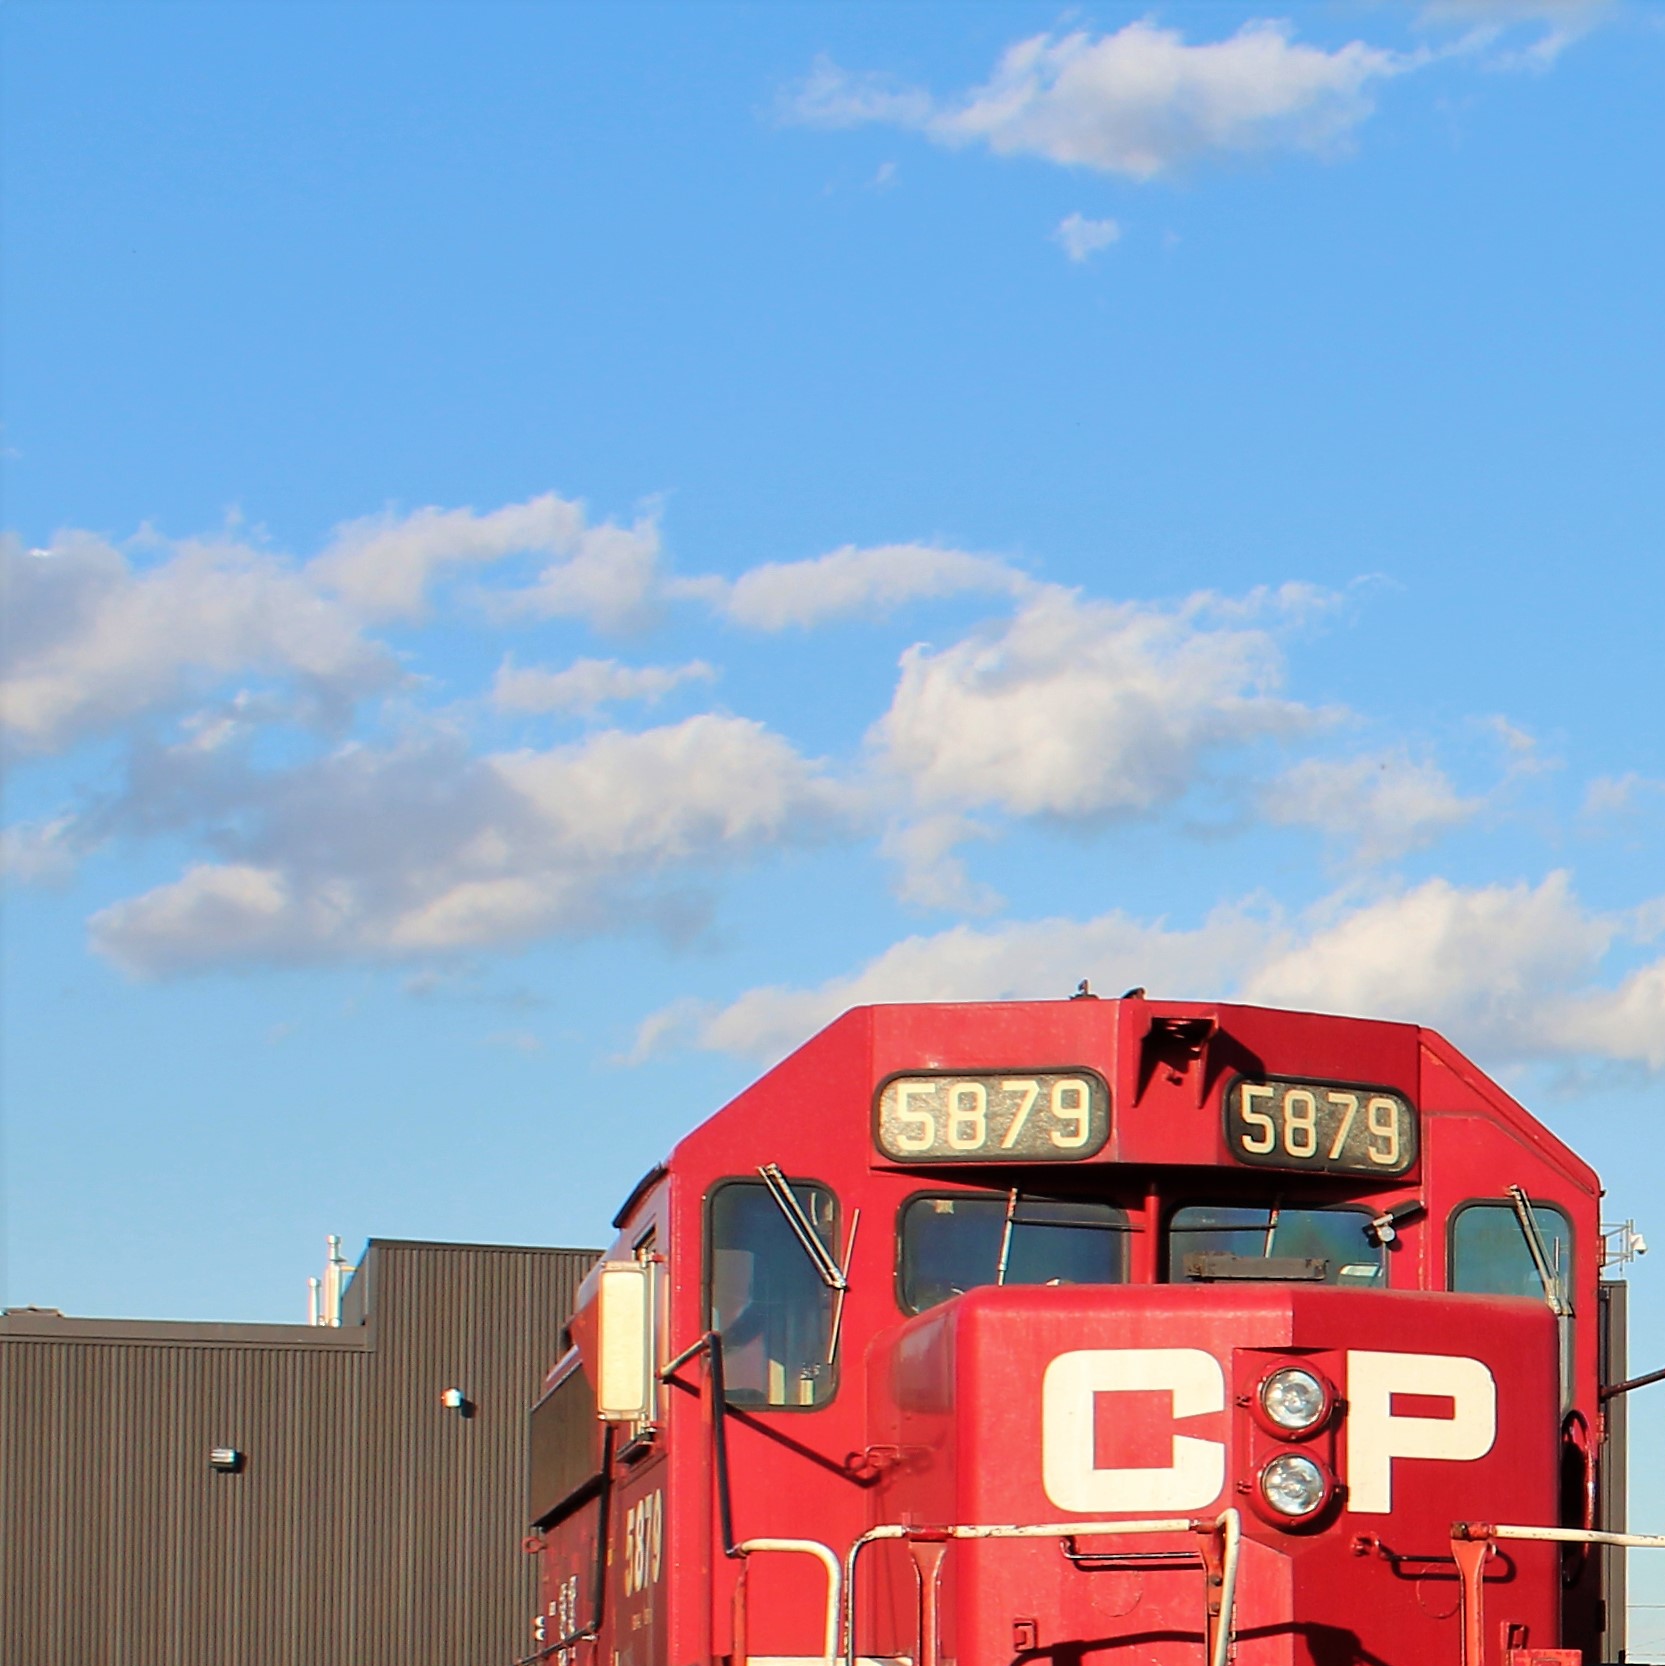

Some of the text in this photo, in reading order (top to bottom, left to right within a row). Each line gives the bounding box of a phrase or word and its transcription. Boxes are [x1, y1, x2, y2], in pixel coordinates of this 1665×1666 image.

[896, 1078, 1090, 1152] 5879
[1240, 1082, 1400, 1166] 5879
[625, 1488, 662, 1598] 5879
